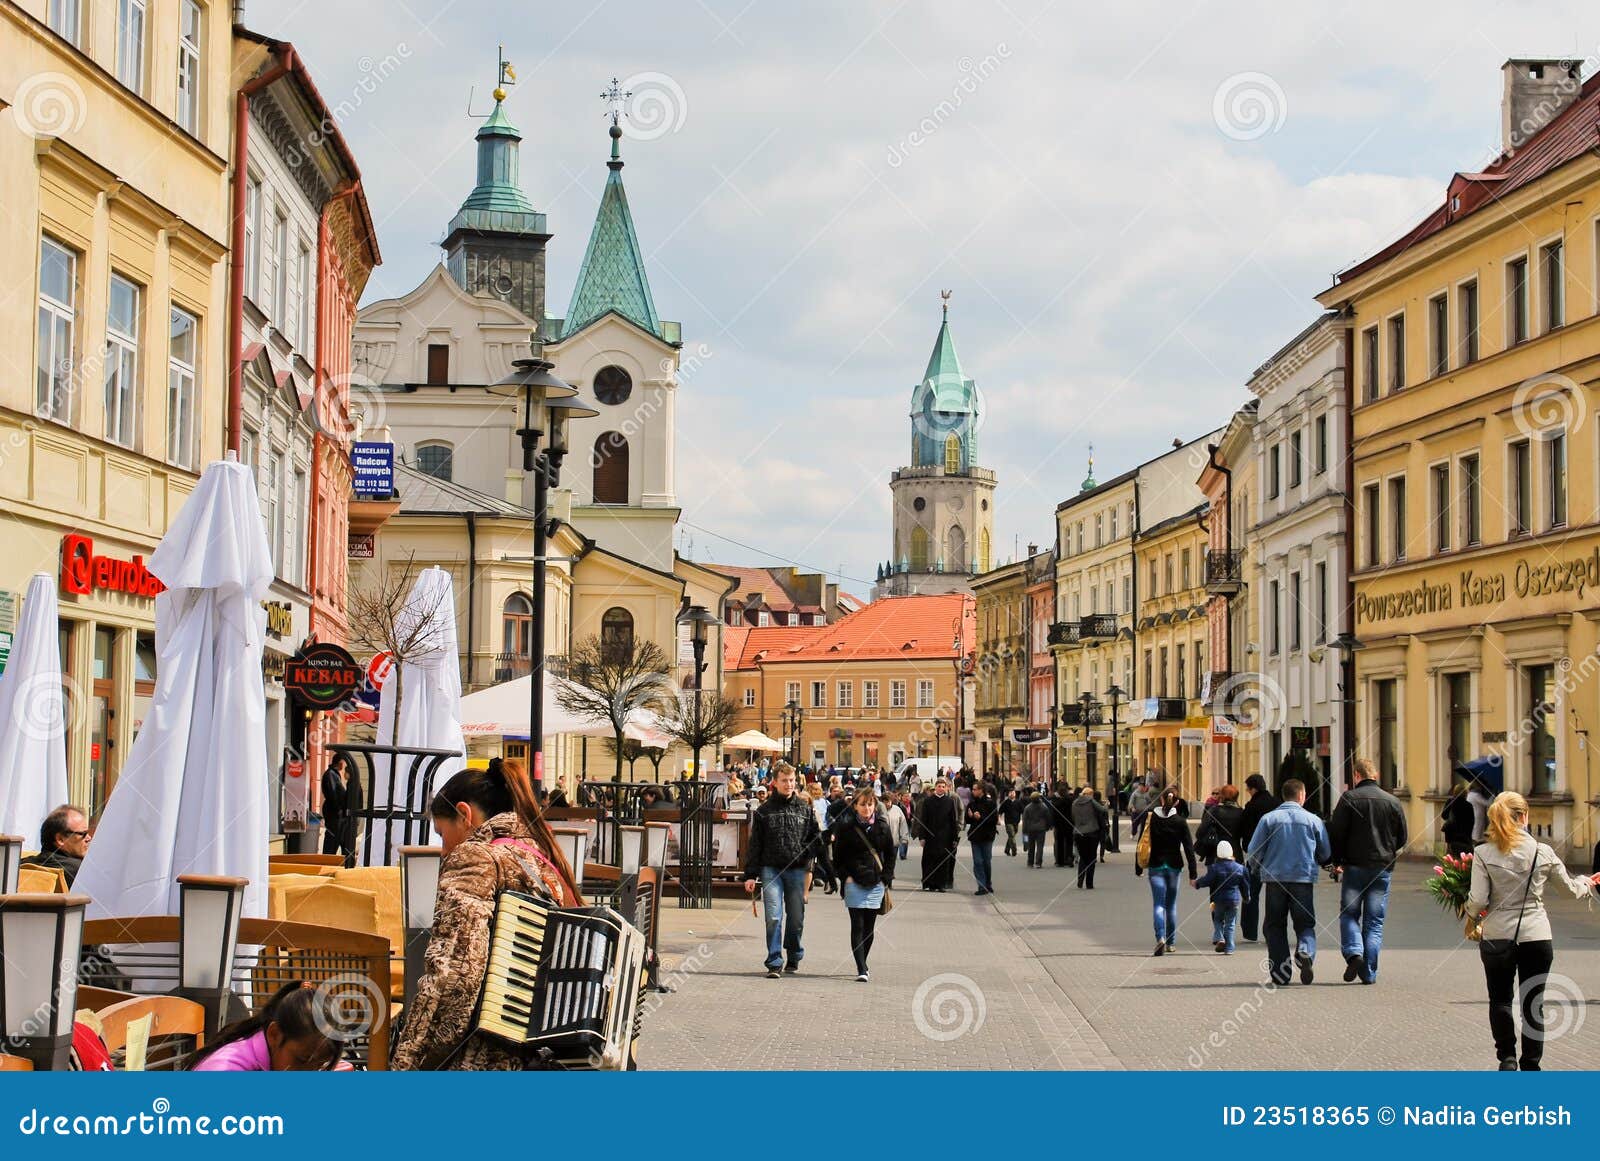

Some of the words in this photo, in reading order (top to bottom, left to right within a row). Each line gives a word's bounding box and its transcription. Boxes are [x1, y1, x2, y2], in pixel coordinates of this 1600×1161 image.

[93, 554, 168, 598] euroba
[1356, 578, 1452, 625] Powszechna
[1460, 569, 1505, 608] Kasa
[1514, 545, 1600, 600] Oszczęd
[294, 668, 355, 685] KEBAB
